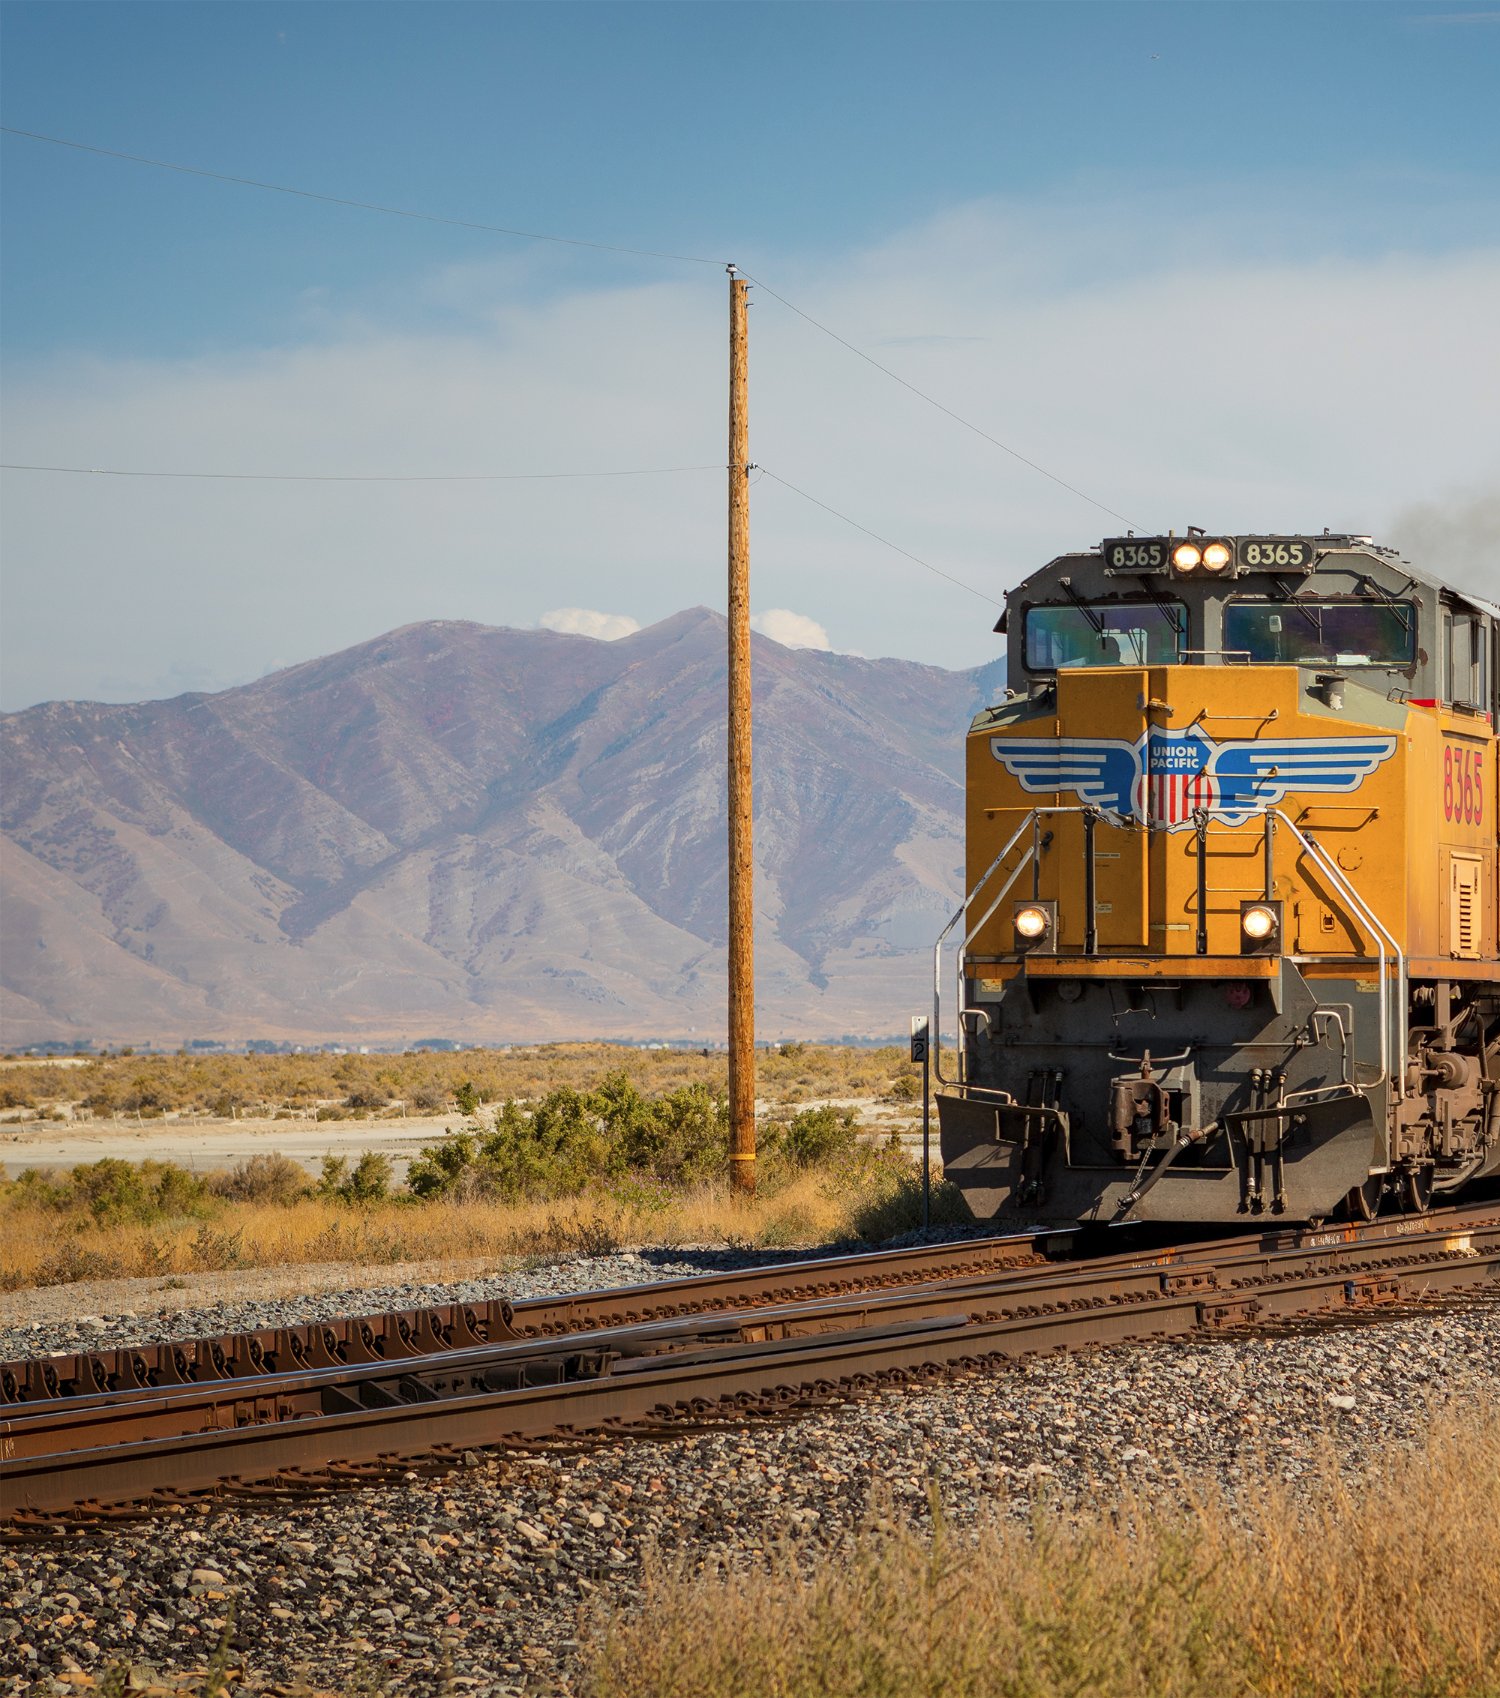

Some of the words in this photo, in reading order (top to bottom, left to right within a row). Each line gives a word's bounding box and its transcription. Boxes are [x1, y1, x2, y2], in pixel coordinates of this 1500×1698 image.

[1113, 546, 1161, 567] 8365
[1247, 544, 1303, 565] 8365
[1153, 746, 1197, 757] UNION
[1150, 758, 1199, 768] PACIFIC
[1443, 745, 1483, 826] 8365
